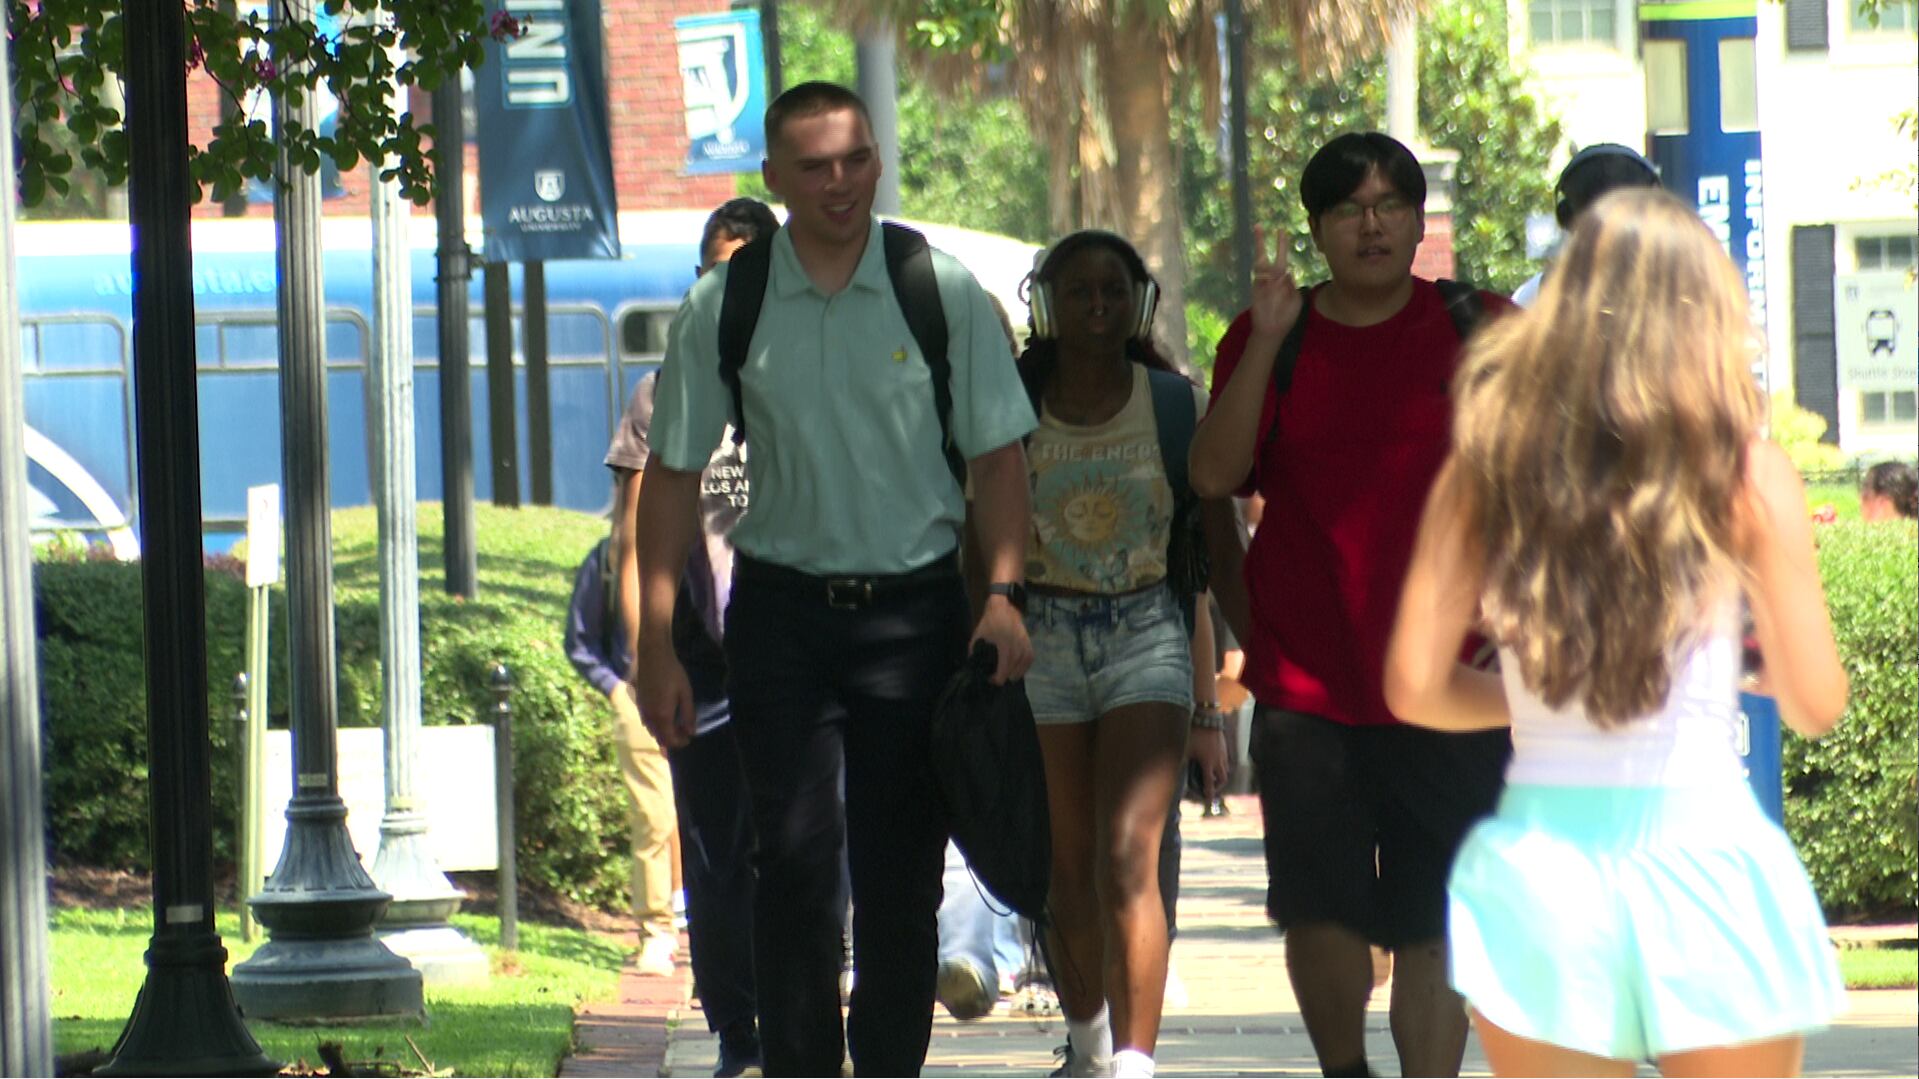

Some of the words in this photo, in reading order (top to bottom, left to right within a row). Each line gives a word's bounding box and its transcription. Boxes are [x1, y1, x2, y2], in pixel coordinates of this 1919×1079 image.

[508, 206, 594, 223] AUGUSTA
[711, 465, 745, 480] NEW
[701, 480, 731, 495] LOS
